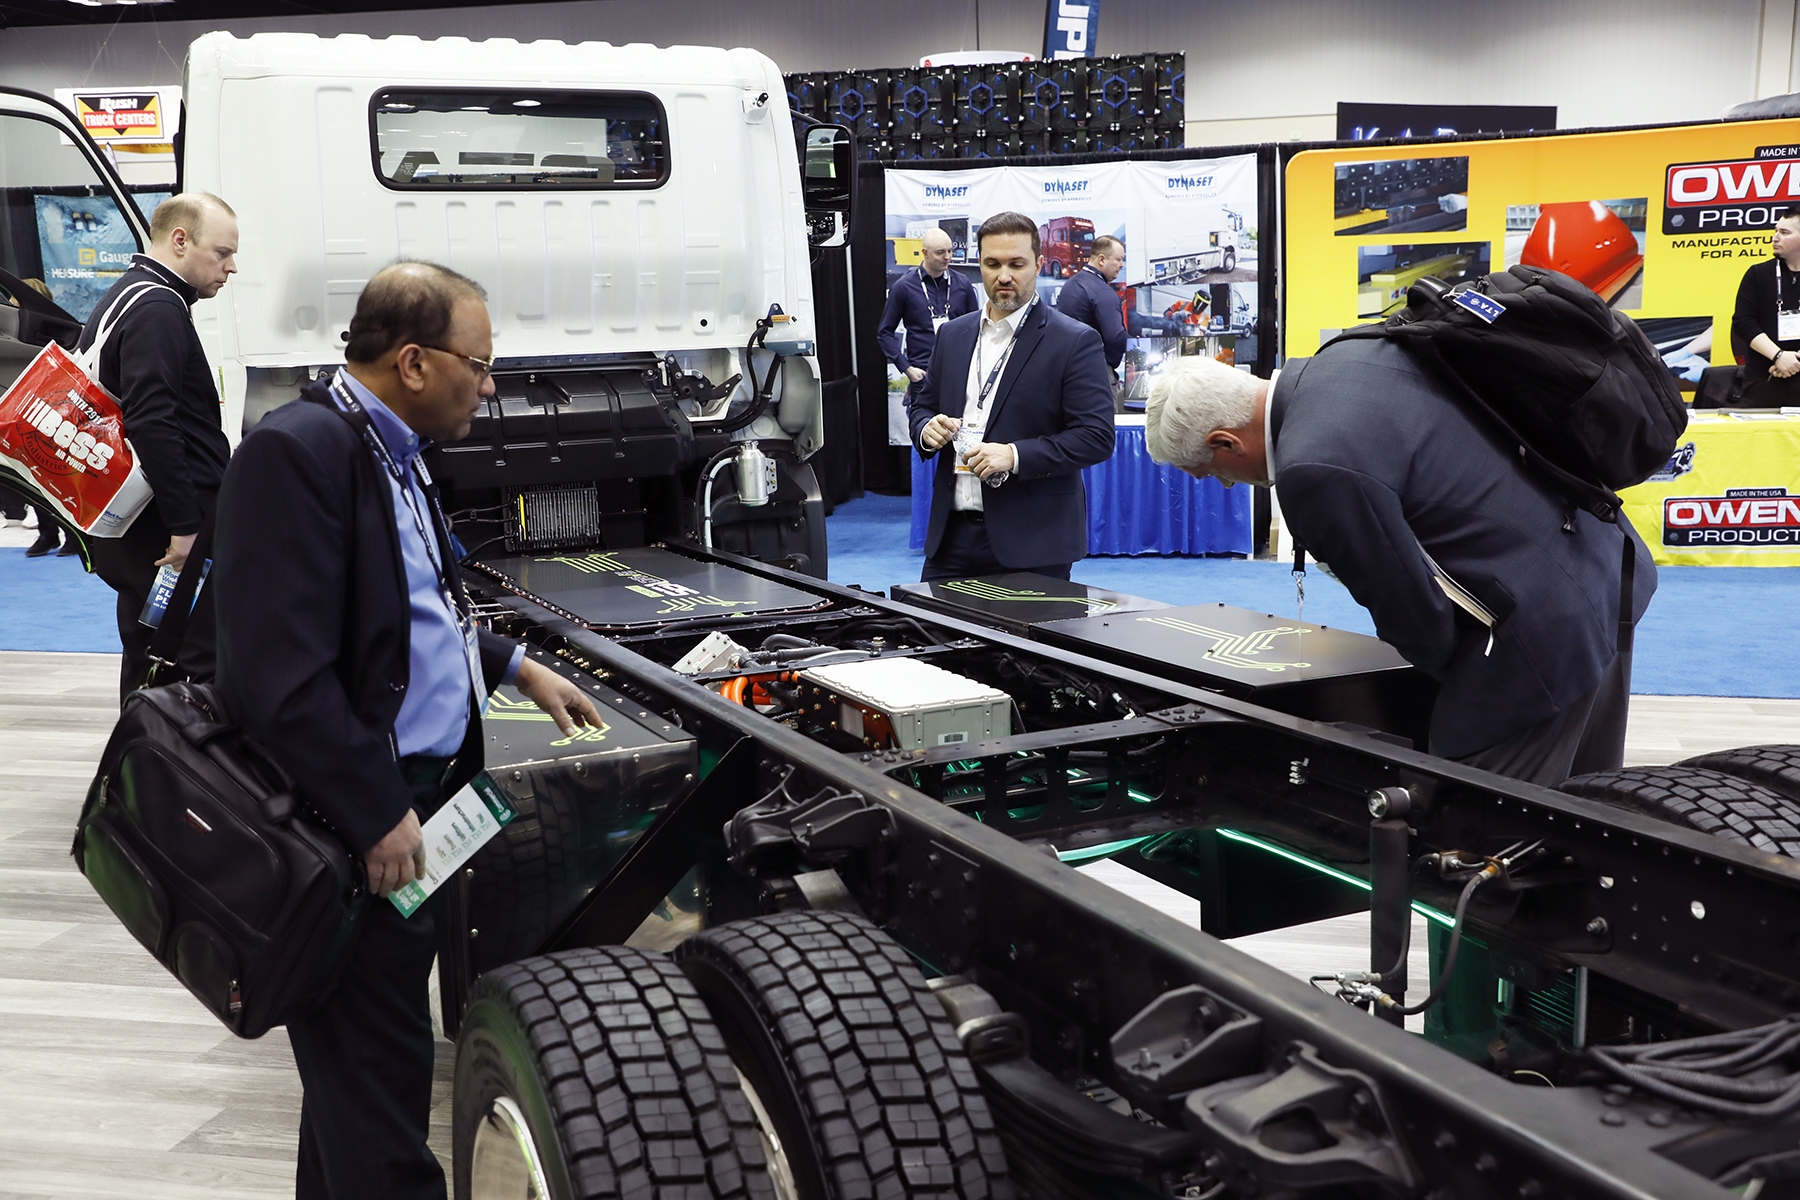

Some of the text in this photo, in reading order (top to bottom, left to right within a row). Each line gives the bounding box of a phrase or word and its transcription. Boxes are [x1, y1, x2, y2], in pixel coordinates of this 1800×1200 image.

[83, 112, 157, 127] TRUCK CENTERS
[1760, 147, 1798, 157] MADE IN
[1044, 178, 1089, 196] DYNASET
[1168, 174, 1214, 192] DYNASET
[925, 183, 968, 200] DYNASET
[1701, 248, 1767, 259] FOR ALL
[51, 268, 95, 279] MEASURE
[66, 389, 88, 412] BOOTH
[55, 449, 67, 461] AIR
[65, 454, 87, 474] POWER
[1688, 529, 1800, 543] PRODUCT
